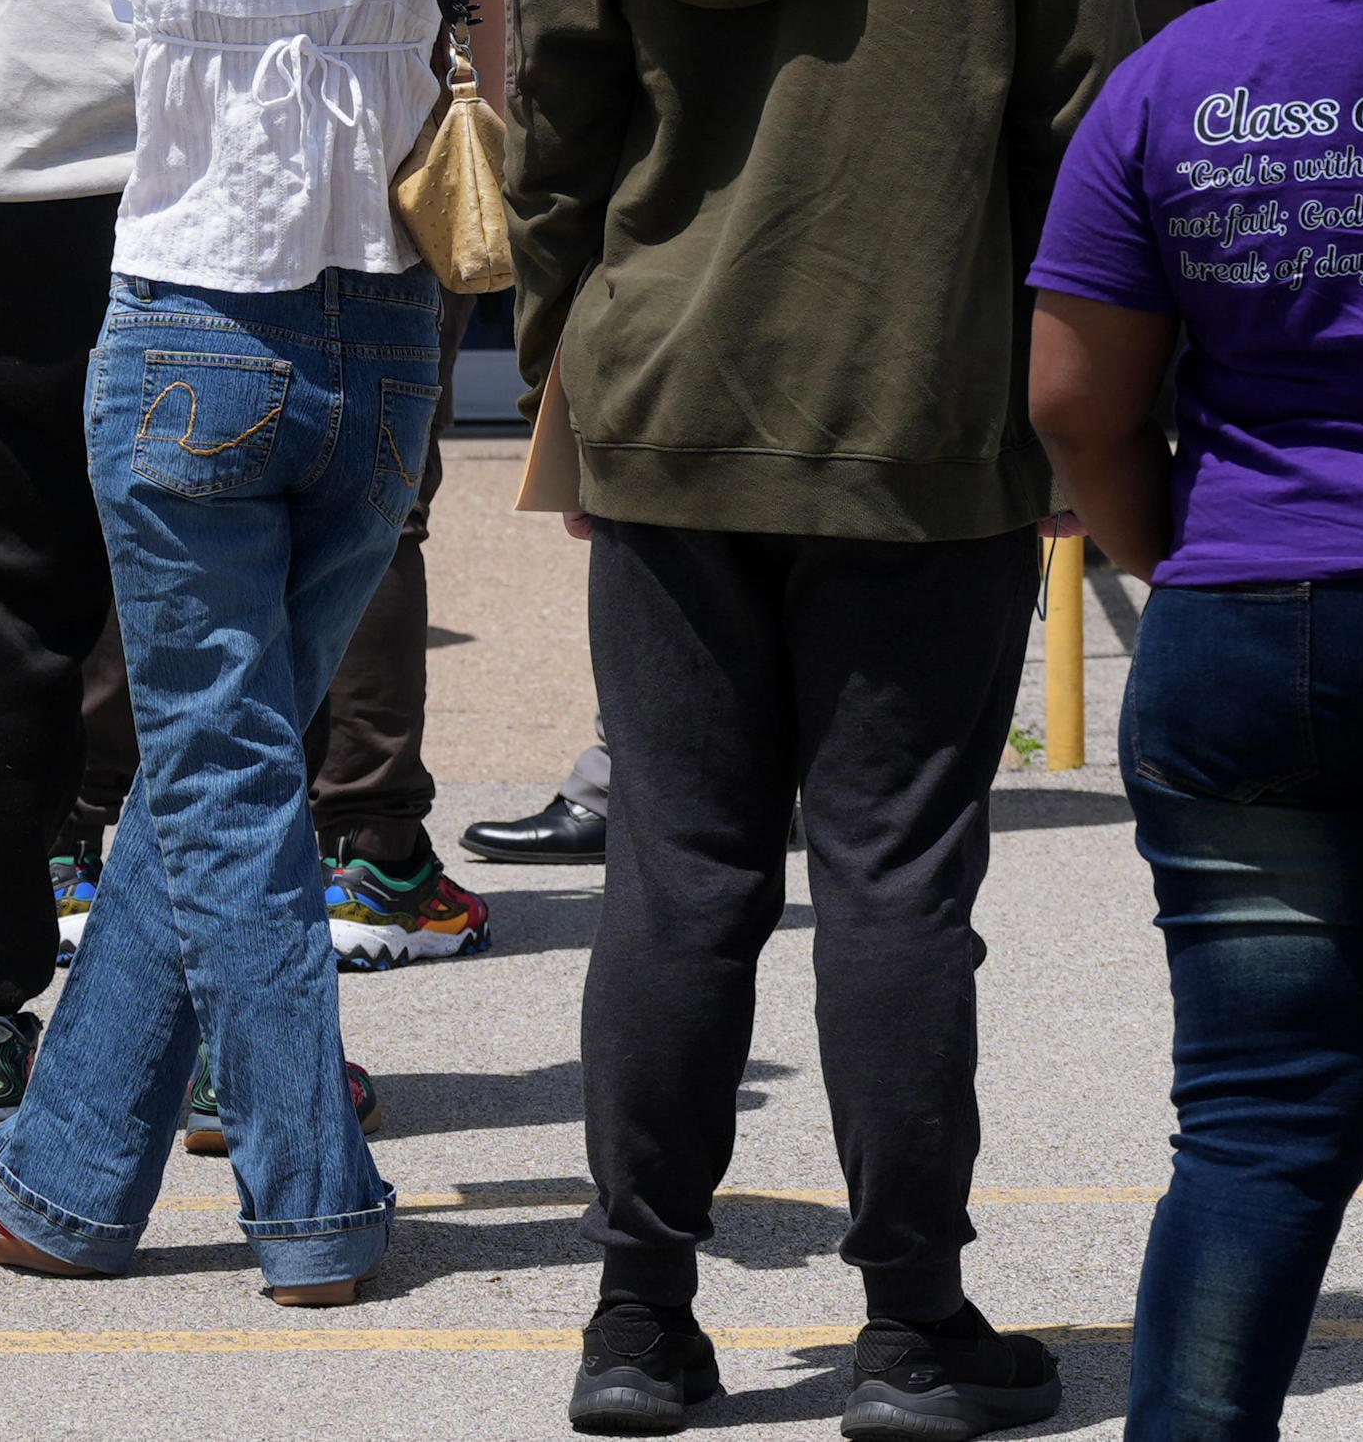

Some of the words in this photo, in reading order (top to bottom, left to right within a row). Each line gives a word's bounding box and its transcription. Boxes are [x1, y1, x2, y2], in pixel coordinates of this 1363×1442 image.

[1194, 87, 1340, 146] Class
[1259, 155, 1287, 185] is
[1169, 211, 1222, 237] not
[1220, 200, 1289, 248] fail;
[1180, 251, 1271, 283] break
[1273, 246, 1314, 291] of
